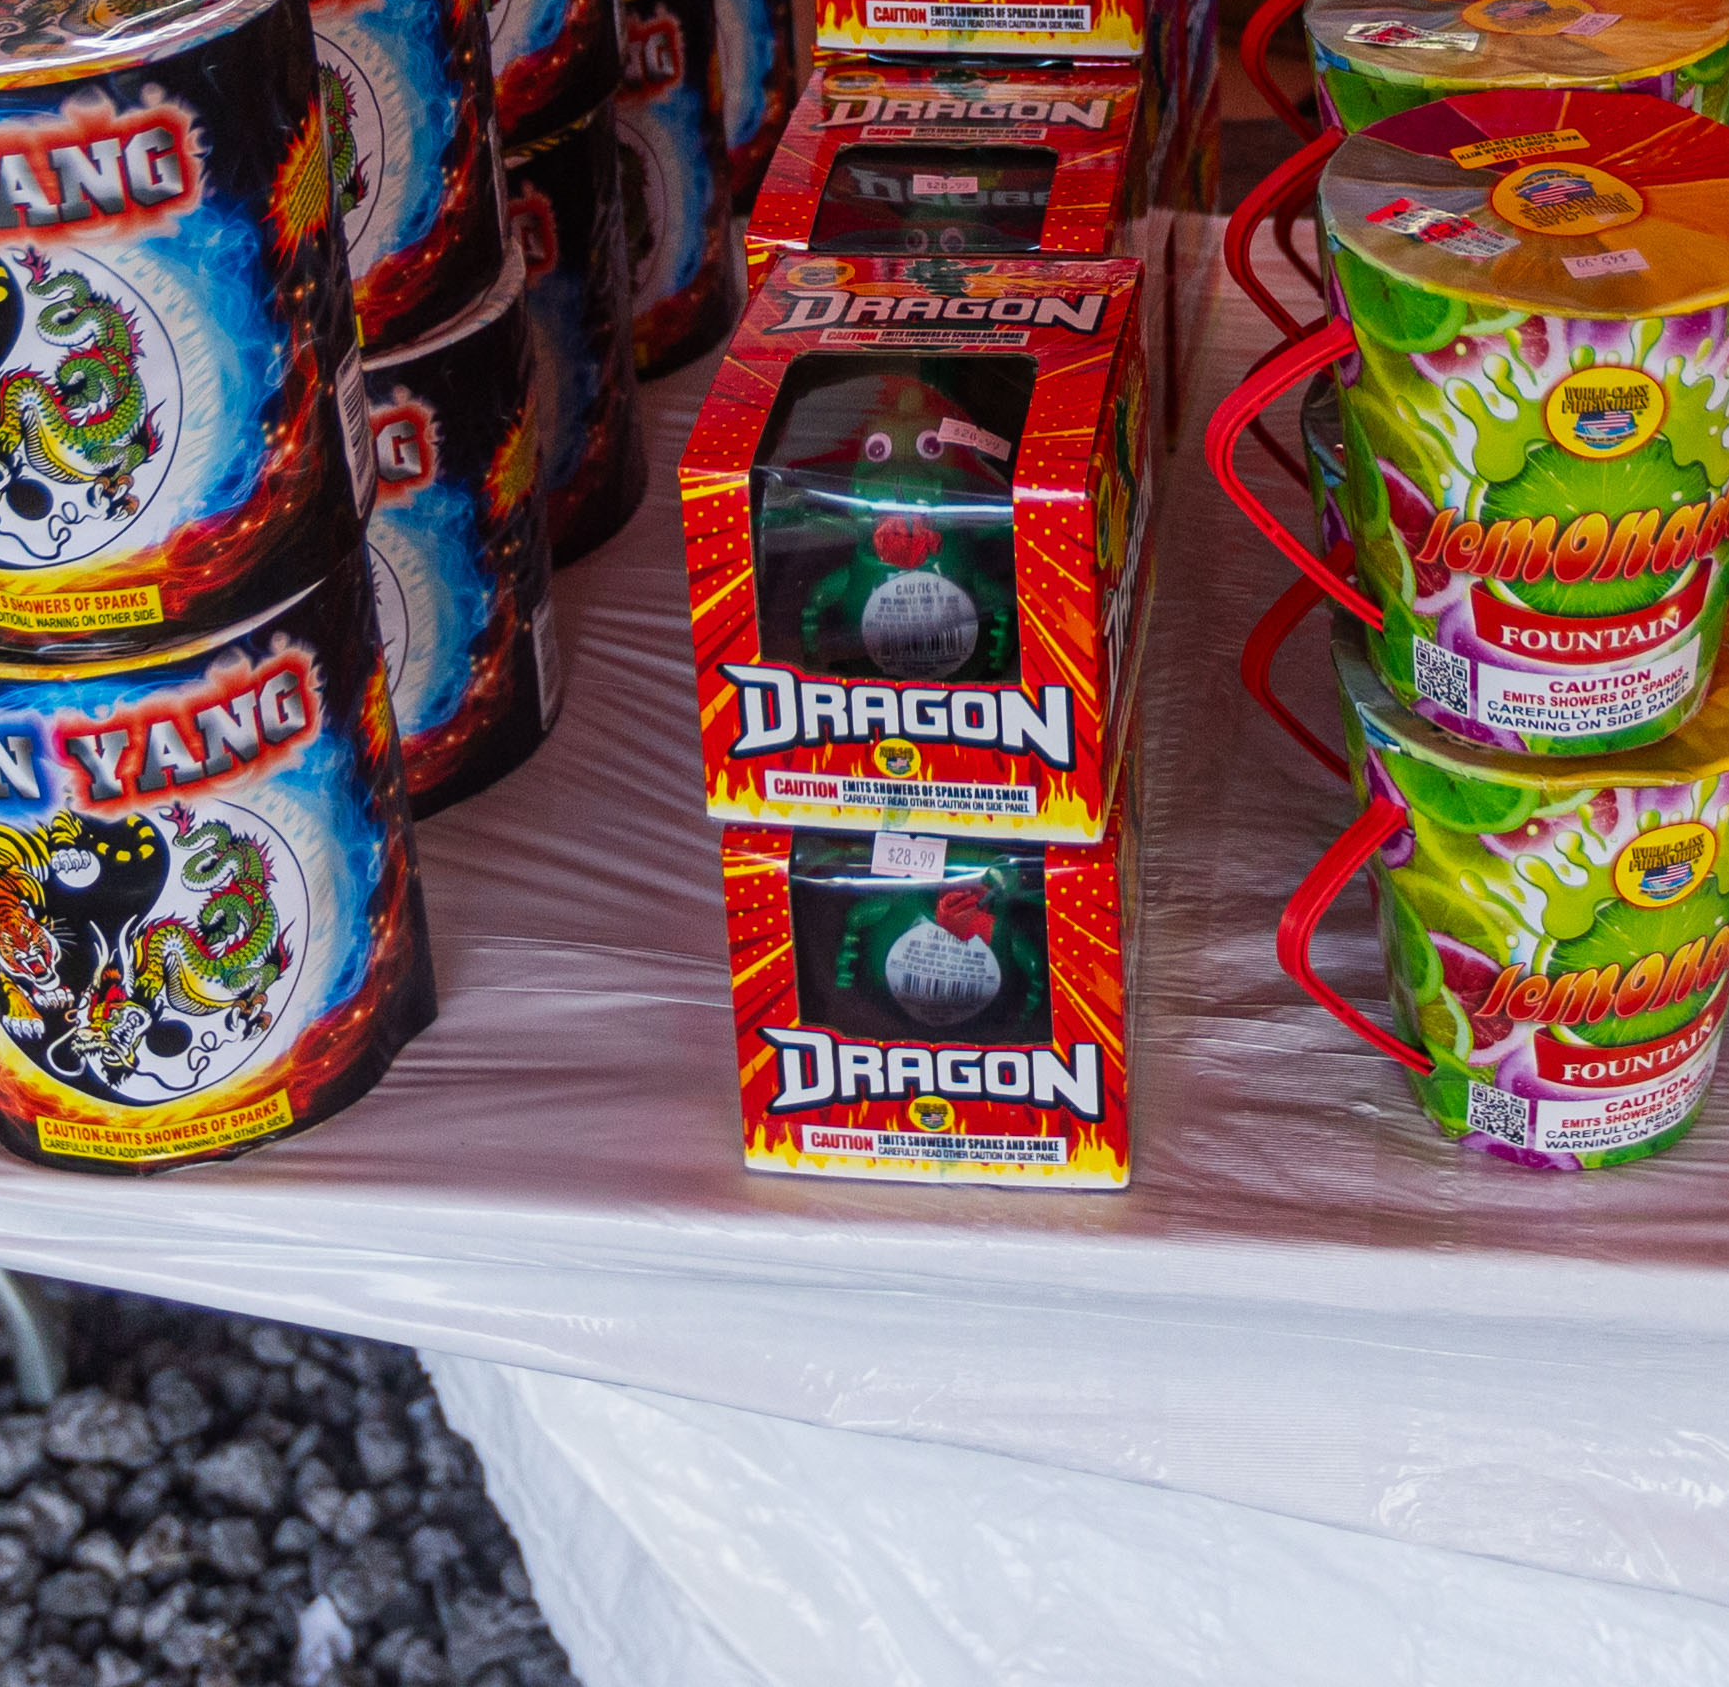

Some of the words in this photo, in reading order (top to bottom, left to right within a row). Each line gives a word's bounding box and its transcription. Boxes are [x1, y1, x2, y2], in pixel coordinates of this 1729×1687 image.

[813, 95, 1111, 132] DRAGON
[764, 289, 1107, 336] DRAGON
[828, 332, 877, 341] CAUTION
[10, 596, 71, 614] SHOWERS
[75, 597, 90, 611] OF
[95, 591, 148, 609] SPARKS
[98, 612, 131, 625] OTHER
[1500, 611, 1682, 651] FOUNTAIN
[1417, 638, 1446, 659] SCAN
[1450, 656, 1466, 668] ME
[1548, 669, 1651, 694] CAUTION
[1487, 700, 1591, 720] CAREFULLY
[1596, 700, 1642, 717] READ
[1502, 690, 1545, 706] EMITS
[1550, 692, 1617, 707] SHOWERS
[719, 663, 1075, 770] DRAGON
[1487, 713, 1571, 733] WARNING
[1576, 719, 1601, 731] ON
[1607, 710, 1643, 727] SIDE
[64, 669, 311, 803] YANG
[774, 777, 838, 798] CAUTION
[842, 780, 871, 793] EMITS
[873, 783, 920, 796] SHOWERS
[935, 786, 972, 799] SPARKS
[995, 788, 1029, 802] SMOKE
[937, 799, 971, 810] CAUTION
[887, 847, 937, 871] $28.99
[1561, 1012, 1716, 1082] FOUNTAIN
[759, 1025, 1104, 1123] DRAGON
[1605, 1073, 1690, 1113] CAUTION
[43, 1121, 141, 1146] CAUTION-EMITS
[145, 1121, 208, 1146] SHOWERS
[231, 1098, 279, 1127] SPARKS
[1562, 1117, 1601, 1129] EMITS
[1605, 1100, 1662, 1125] SHOWERS
[811, 1131, 873, 1152] CAUTION
[878, 1134, 906, 1146] EMITS
[907, 1135, 953, 1148] SHOWERS
[967, 1137, 1005, 1150] SPARKS
[1027, 1139, 1059, 1152] SMOKE
[1546, 1119, 1641, 1139] CAREFULLY
[1544, 1136, 1622, 1149] WARNING
